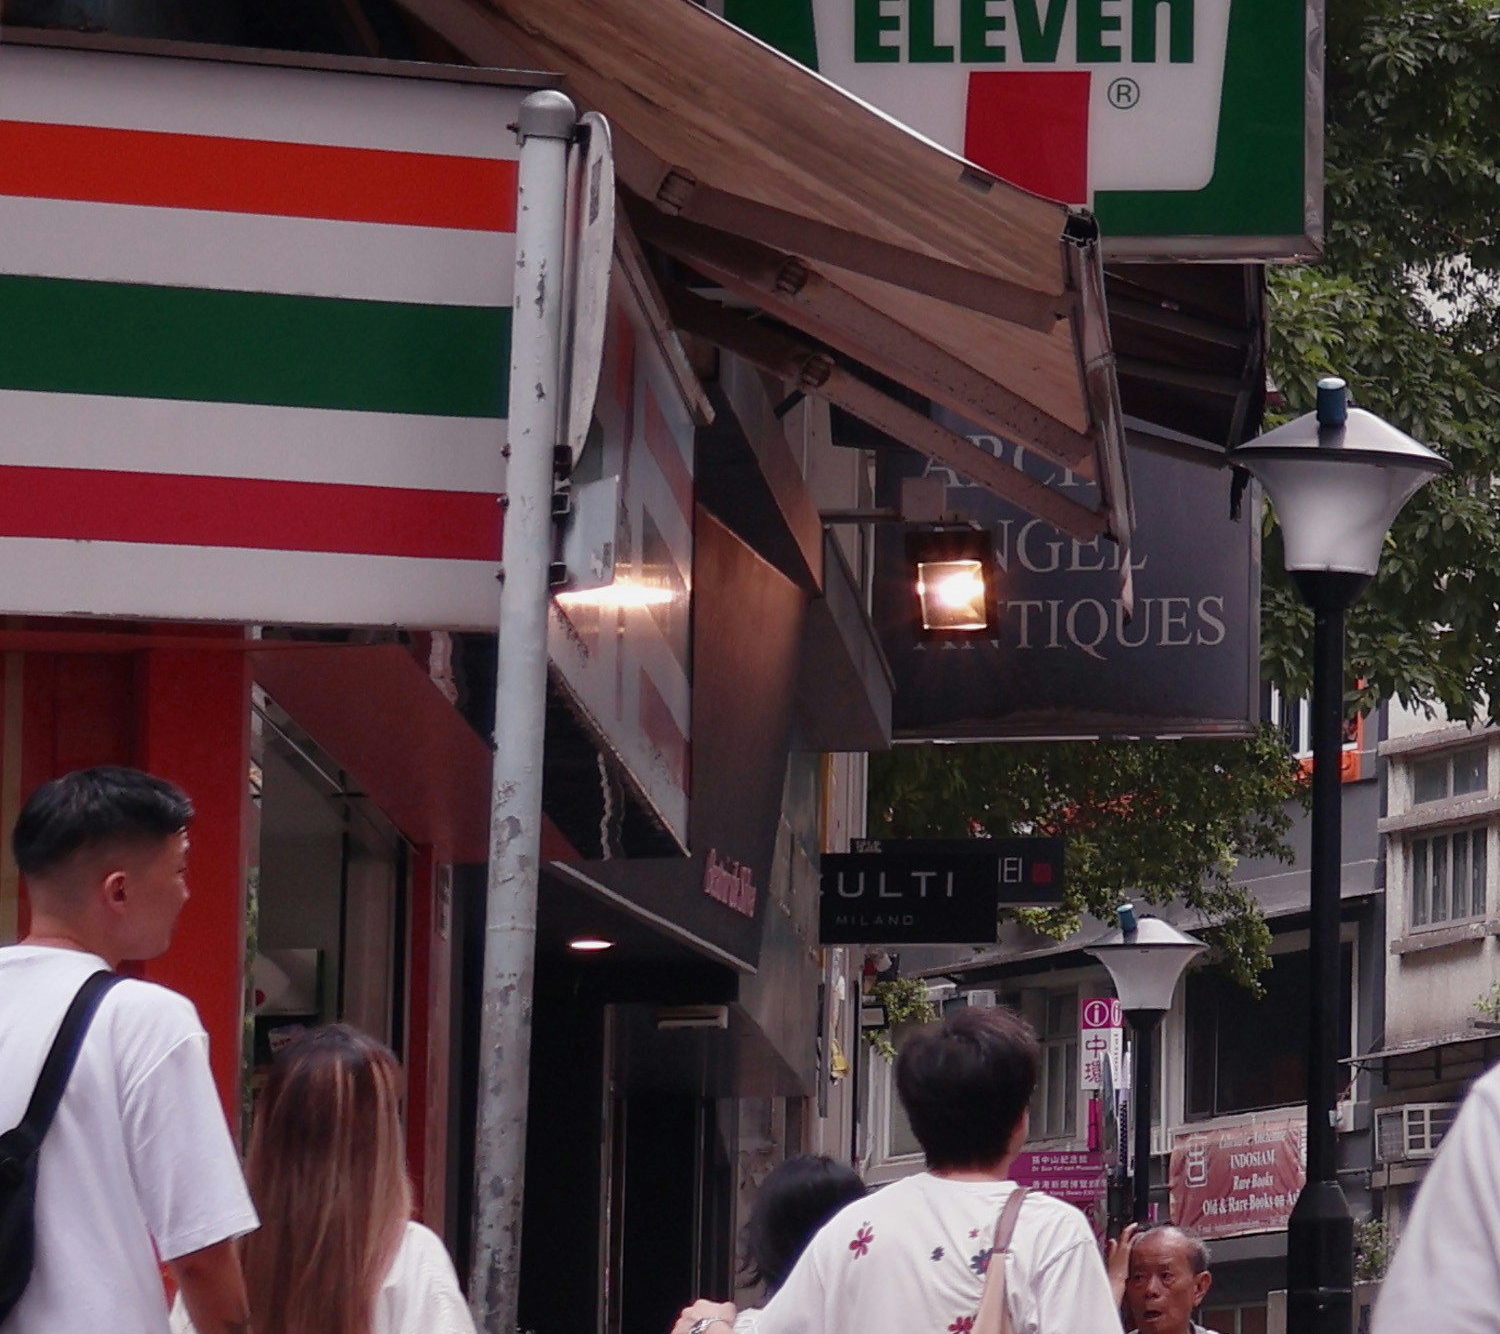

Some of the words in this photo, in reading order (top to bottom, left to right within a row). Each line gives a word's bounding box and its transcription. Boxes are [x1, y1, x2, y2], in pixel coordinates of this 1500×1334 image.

[818, 871, 954, 898] ULTI
[835, 914, 914, 926] MILANO
[1230, 1149, 1275, 1169] INDOSIAM
[1233, 1175, 1251, 1190] Rare
[1252, 1172, 1274, 1188] Books
[1202, 1199, 1217, 1216] Old
[1218, 1199, 1228, 1214] &
[1228, 1196, 1247, 1213] Rare
[1249, 1192, 1273, 1210] Books
[1274, 1195, 1284, 1206] on
